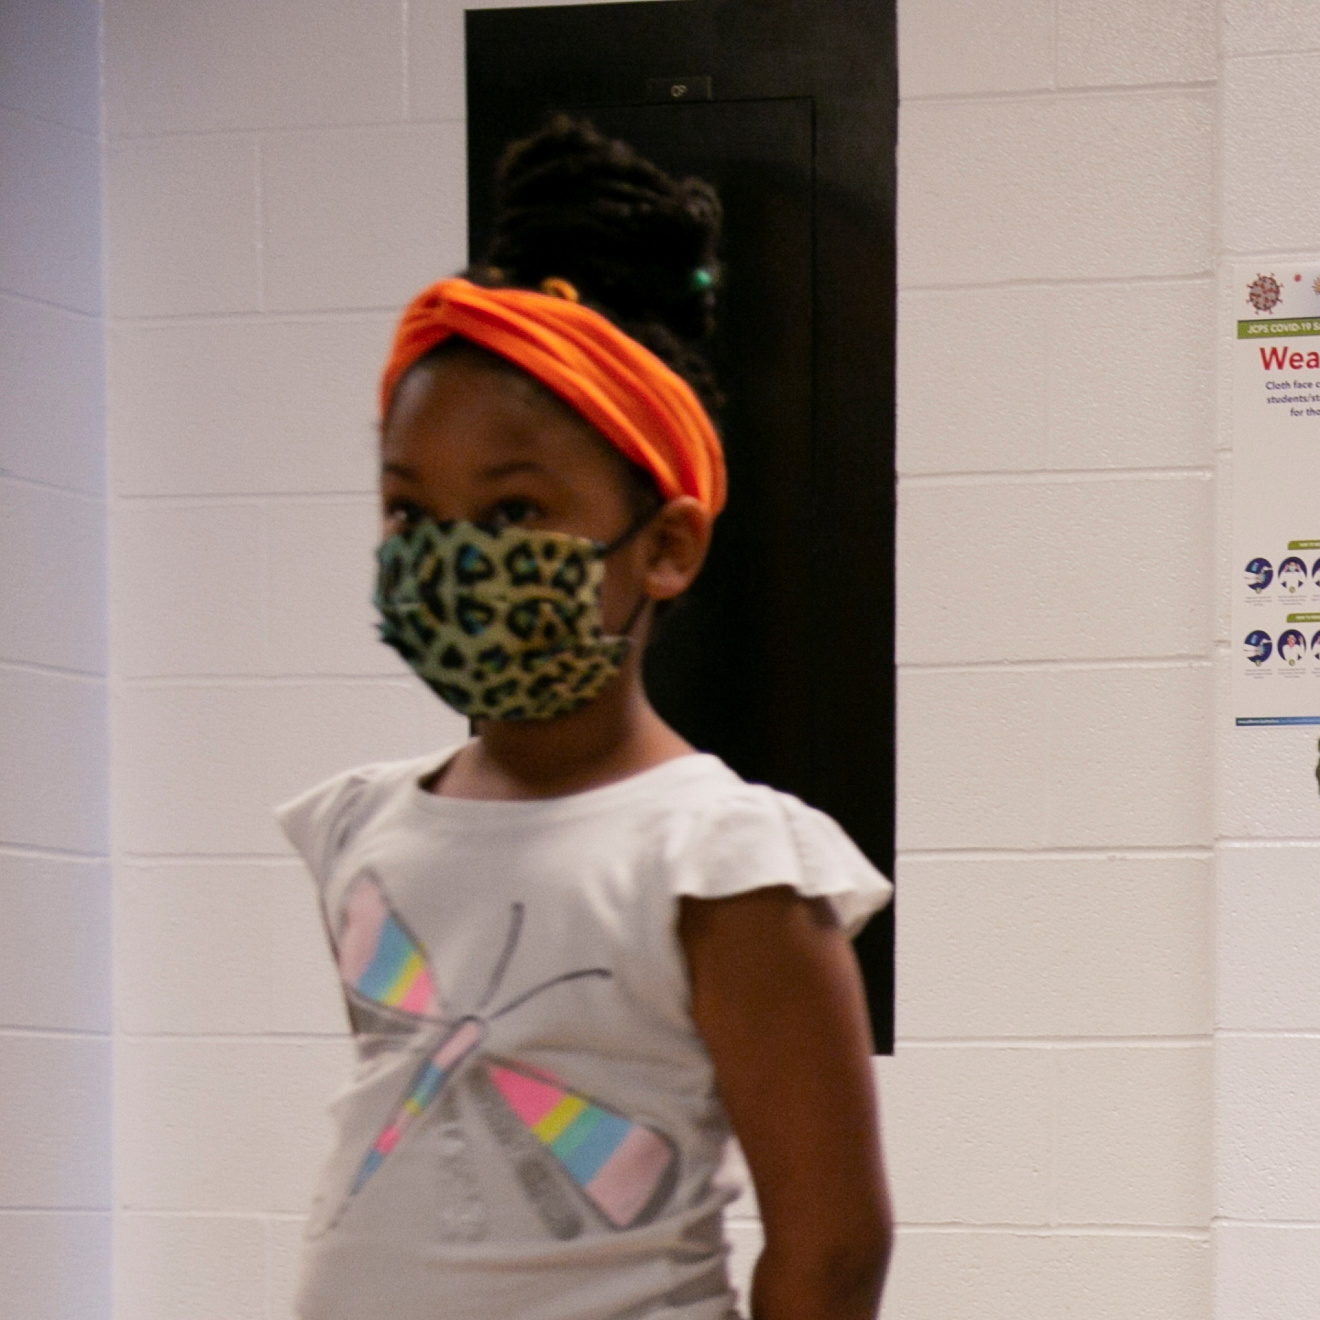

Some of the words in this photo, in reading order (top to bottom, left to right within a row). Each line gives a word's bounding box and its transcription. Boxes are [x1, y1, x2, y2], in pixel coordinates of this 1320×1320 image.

[1248, 324, 1268, 334] JCPS
[1270, 322, 1311, 333] COVID-19
[1265, 381, 1291, 390] Cloth
[1293, 379, 1313, 389] face
[1290, 407, 1303, 416] for
